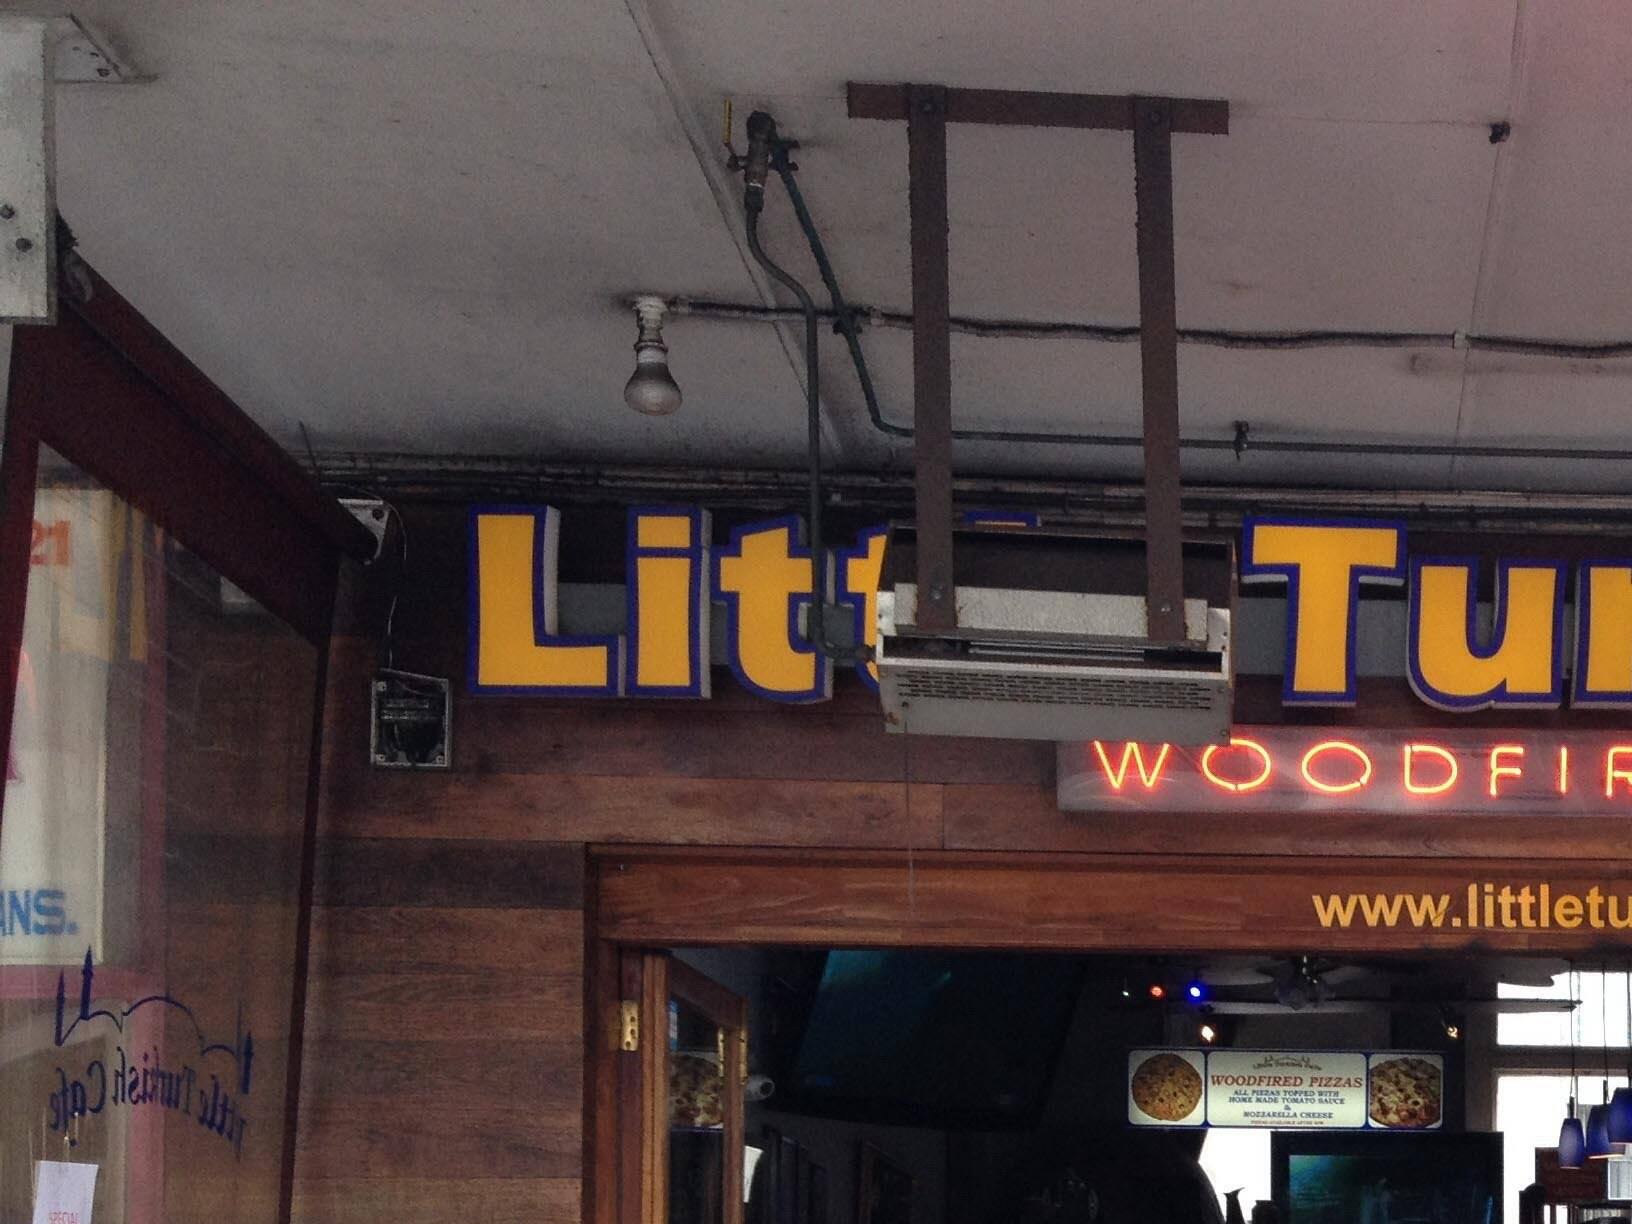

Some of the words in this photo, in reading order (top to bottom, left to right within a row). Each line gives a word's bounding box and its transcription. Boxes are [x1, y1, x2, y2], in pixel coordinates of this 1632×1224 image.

[468, 503, 1042, 702] Lit
[0, 888, 80, 936] NS.
[1211, 1075, 1304, 1087] WOODFIRED
[1309, 1076, 1364, 1089] PIZZAS
